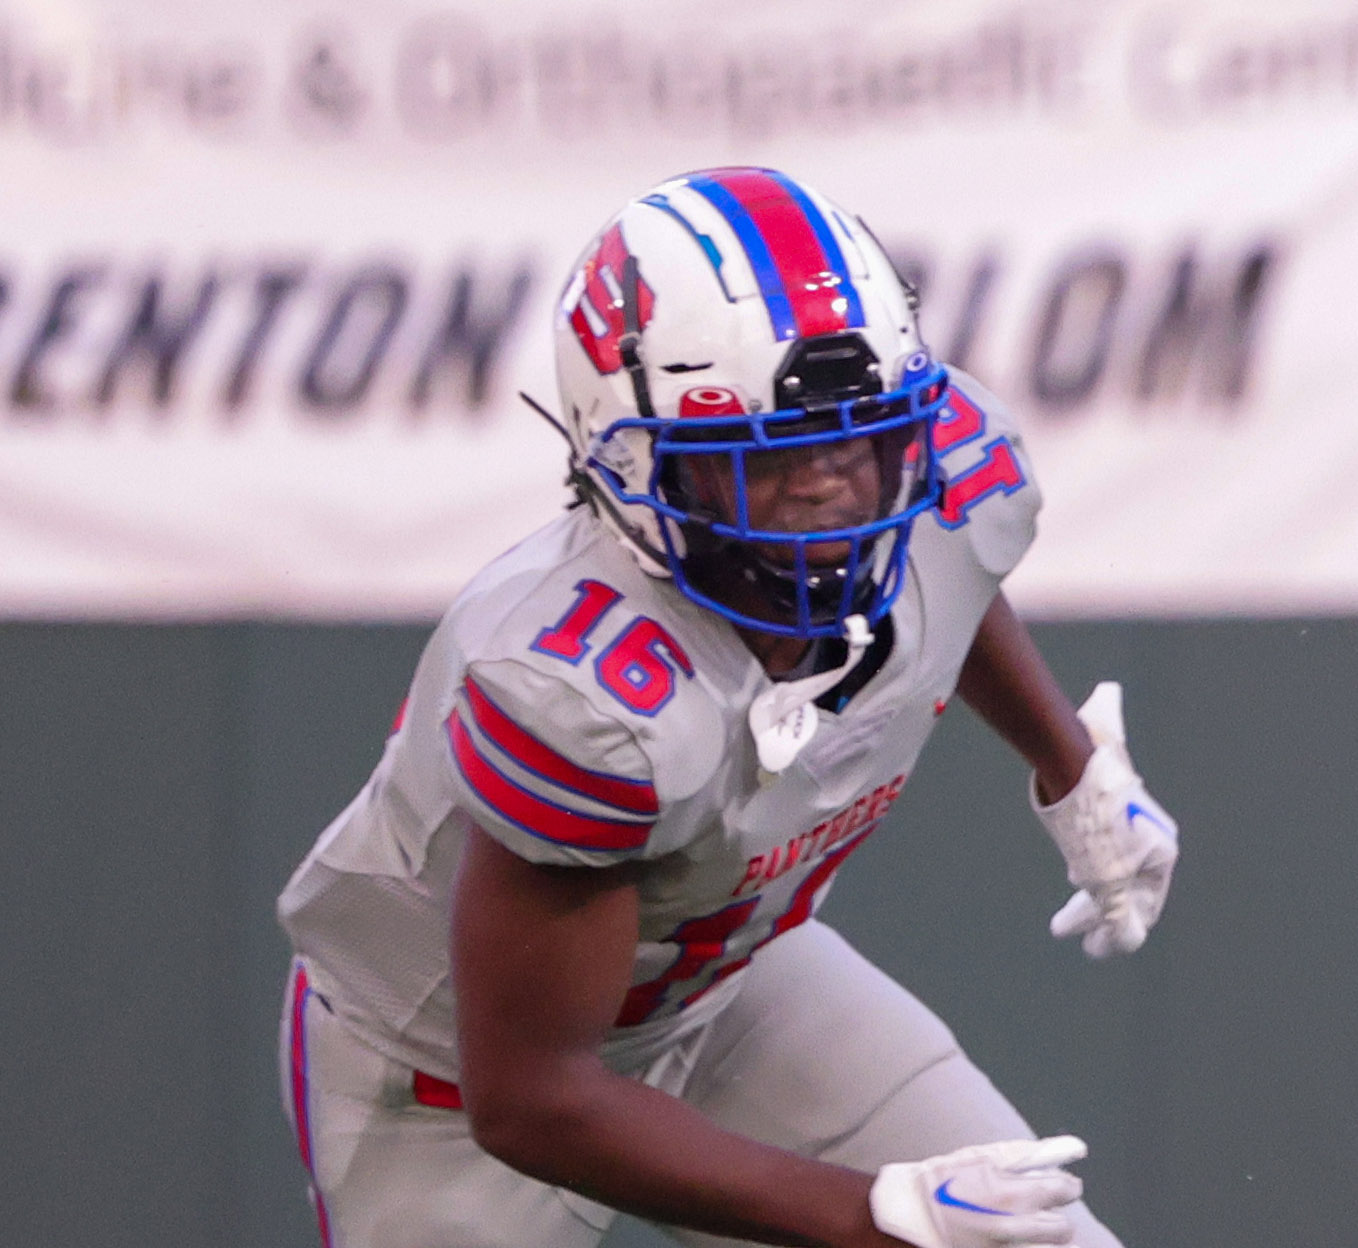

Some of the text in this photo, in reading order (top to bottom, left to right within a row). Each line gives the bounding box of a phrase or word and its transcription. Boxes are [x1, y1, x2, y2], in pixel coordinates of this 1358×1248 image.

[0, 252, 535, 412] ENTON
[530, 578, 695, 718] 16
[731, 774, 906, 896] PANTHERS
